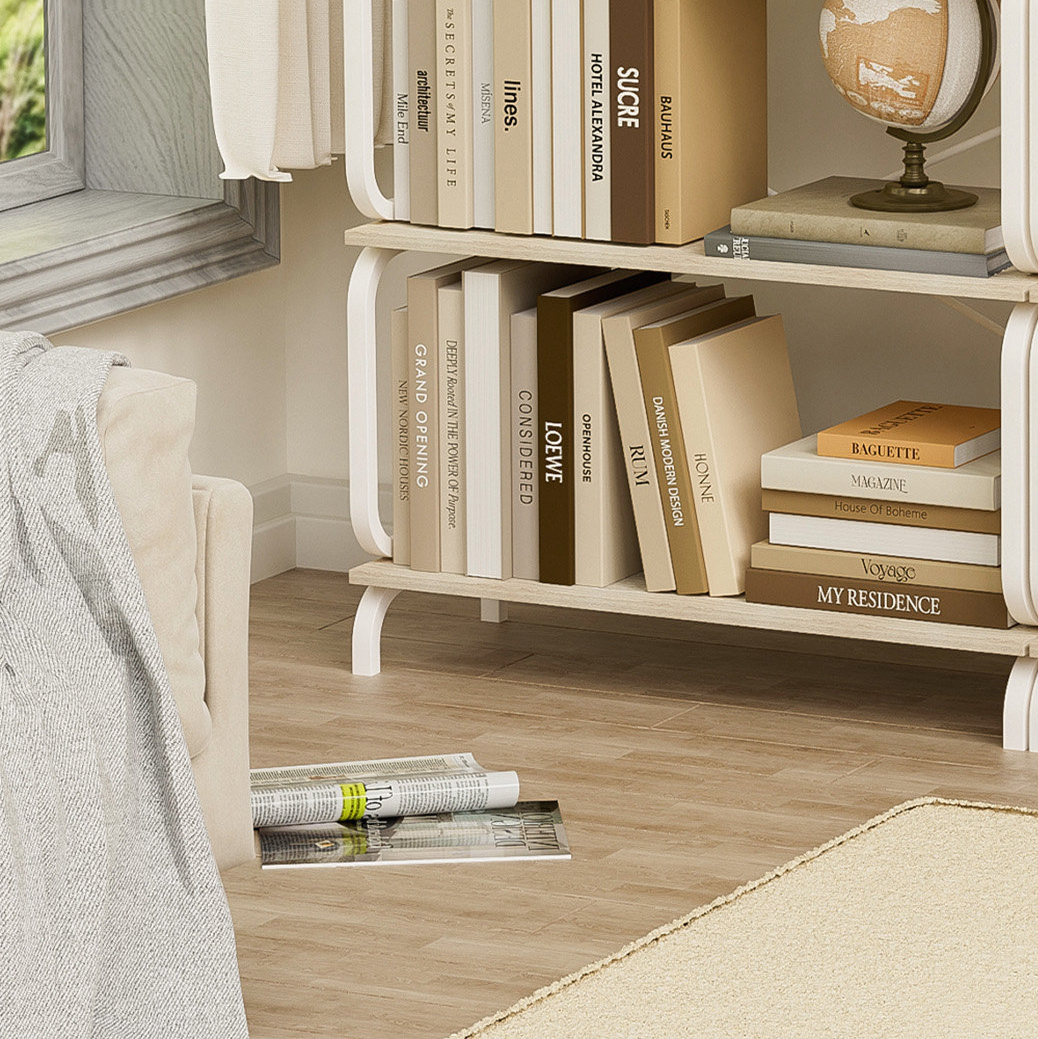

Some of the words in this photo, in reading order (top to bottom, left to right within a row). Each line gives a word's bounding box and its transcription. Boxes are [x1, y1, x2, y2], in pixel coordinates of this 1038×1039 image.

[591, 54, 602, 96] HOTEL
[617, 67, 639, 127] SUCRE
[398, 94, 408, 117] Mile
[417, 71, 431, 131] architectuur
[504, 81, 520, 131] lines.
[398, 122, 409, 144] End
[592, 100, 603, 181] ALEXANDRA
[661, 96, 672, 159] BAUHAUS
[416, 344, 427, 403] GRAND
[652, 396, 670, 437] DANISH
[416, 411, 428, 487] OPENING
[519, 391, 532, 504] CONSIDERED
[545, 422, 562, 483] LOEWE
[582, 414, 592, 483] OPENHOUSE
[628, 445, 650, 486] RUM
[659, 438, 677, 486] MODERN
[852, 442, 920, 460] BAGUETTE
[694, 452, 714, 504] HONNE
[851, 474, 909, 494] MAGAZINE
[667, 487, 684, 527] DESIGN
[834, 501, 867, 514] House
[870, 503, 884, 515] Of
[886, 505, 927, 519] Boheme
[861, 558, 917, 582] Voyage
[817, 585, 844, 605] MY
[847, 589, 941, 614] RESIDENCE
